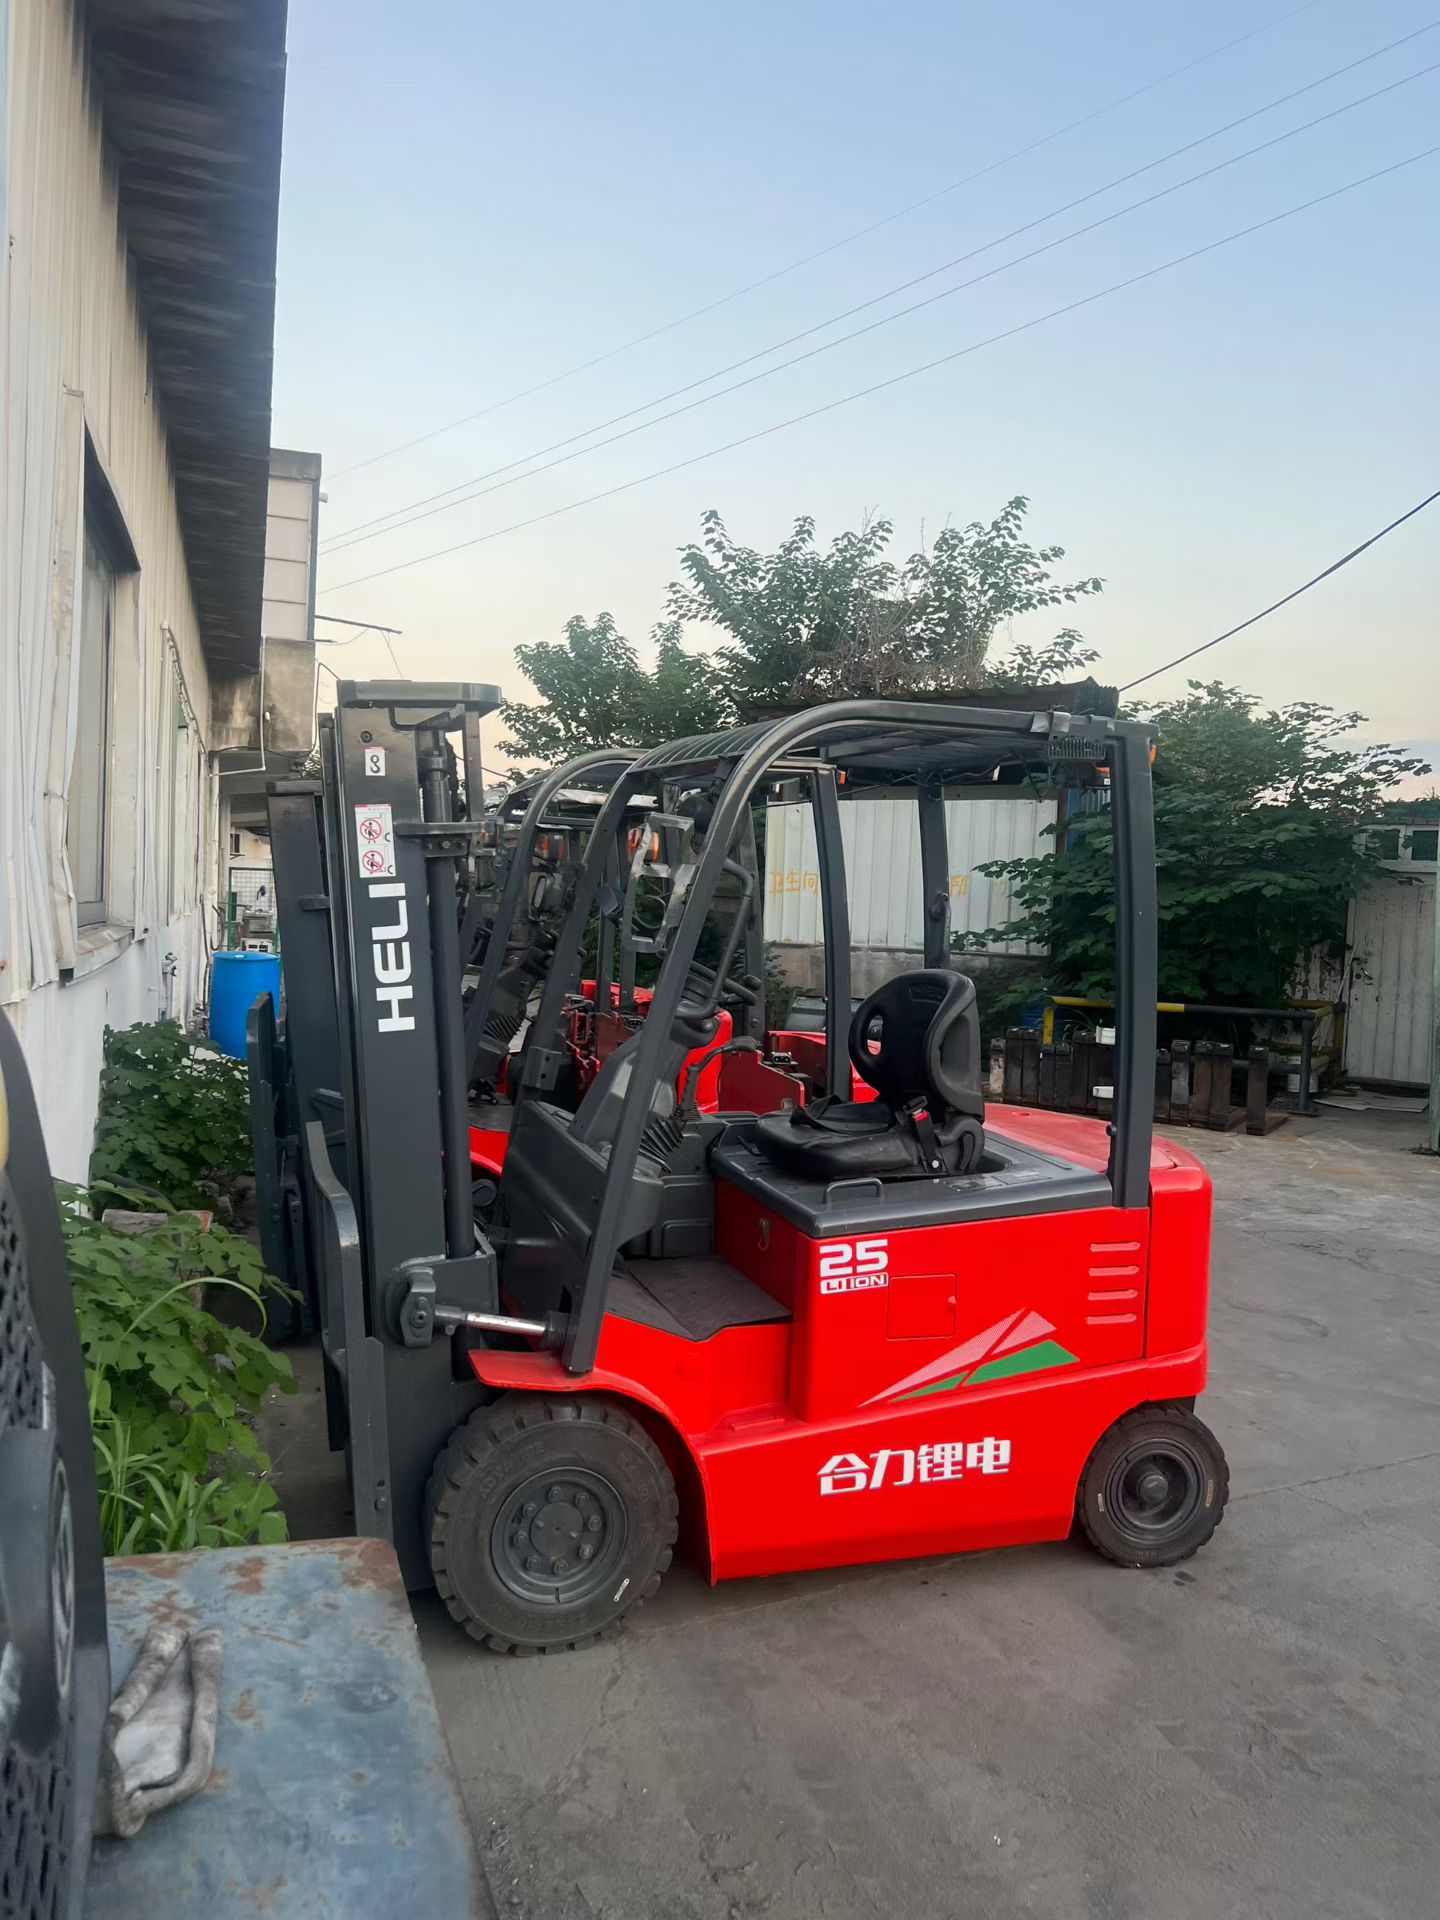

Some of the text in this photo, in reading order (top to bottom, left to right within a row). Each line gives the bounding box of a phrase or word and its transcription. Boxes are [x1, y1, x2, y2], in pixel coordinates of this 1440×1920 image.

[368, 883, 415, 1032] HELI
[819, 1239, 888, 1277] 25
[816, 1436, 1012, 1496] 合力锂电
